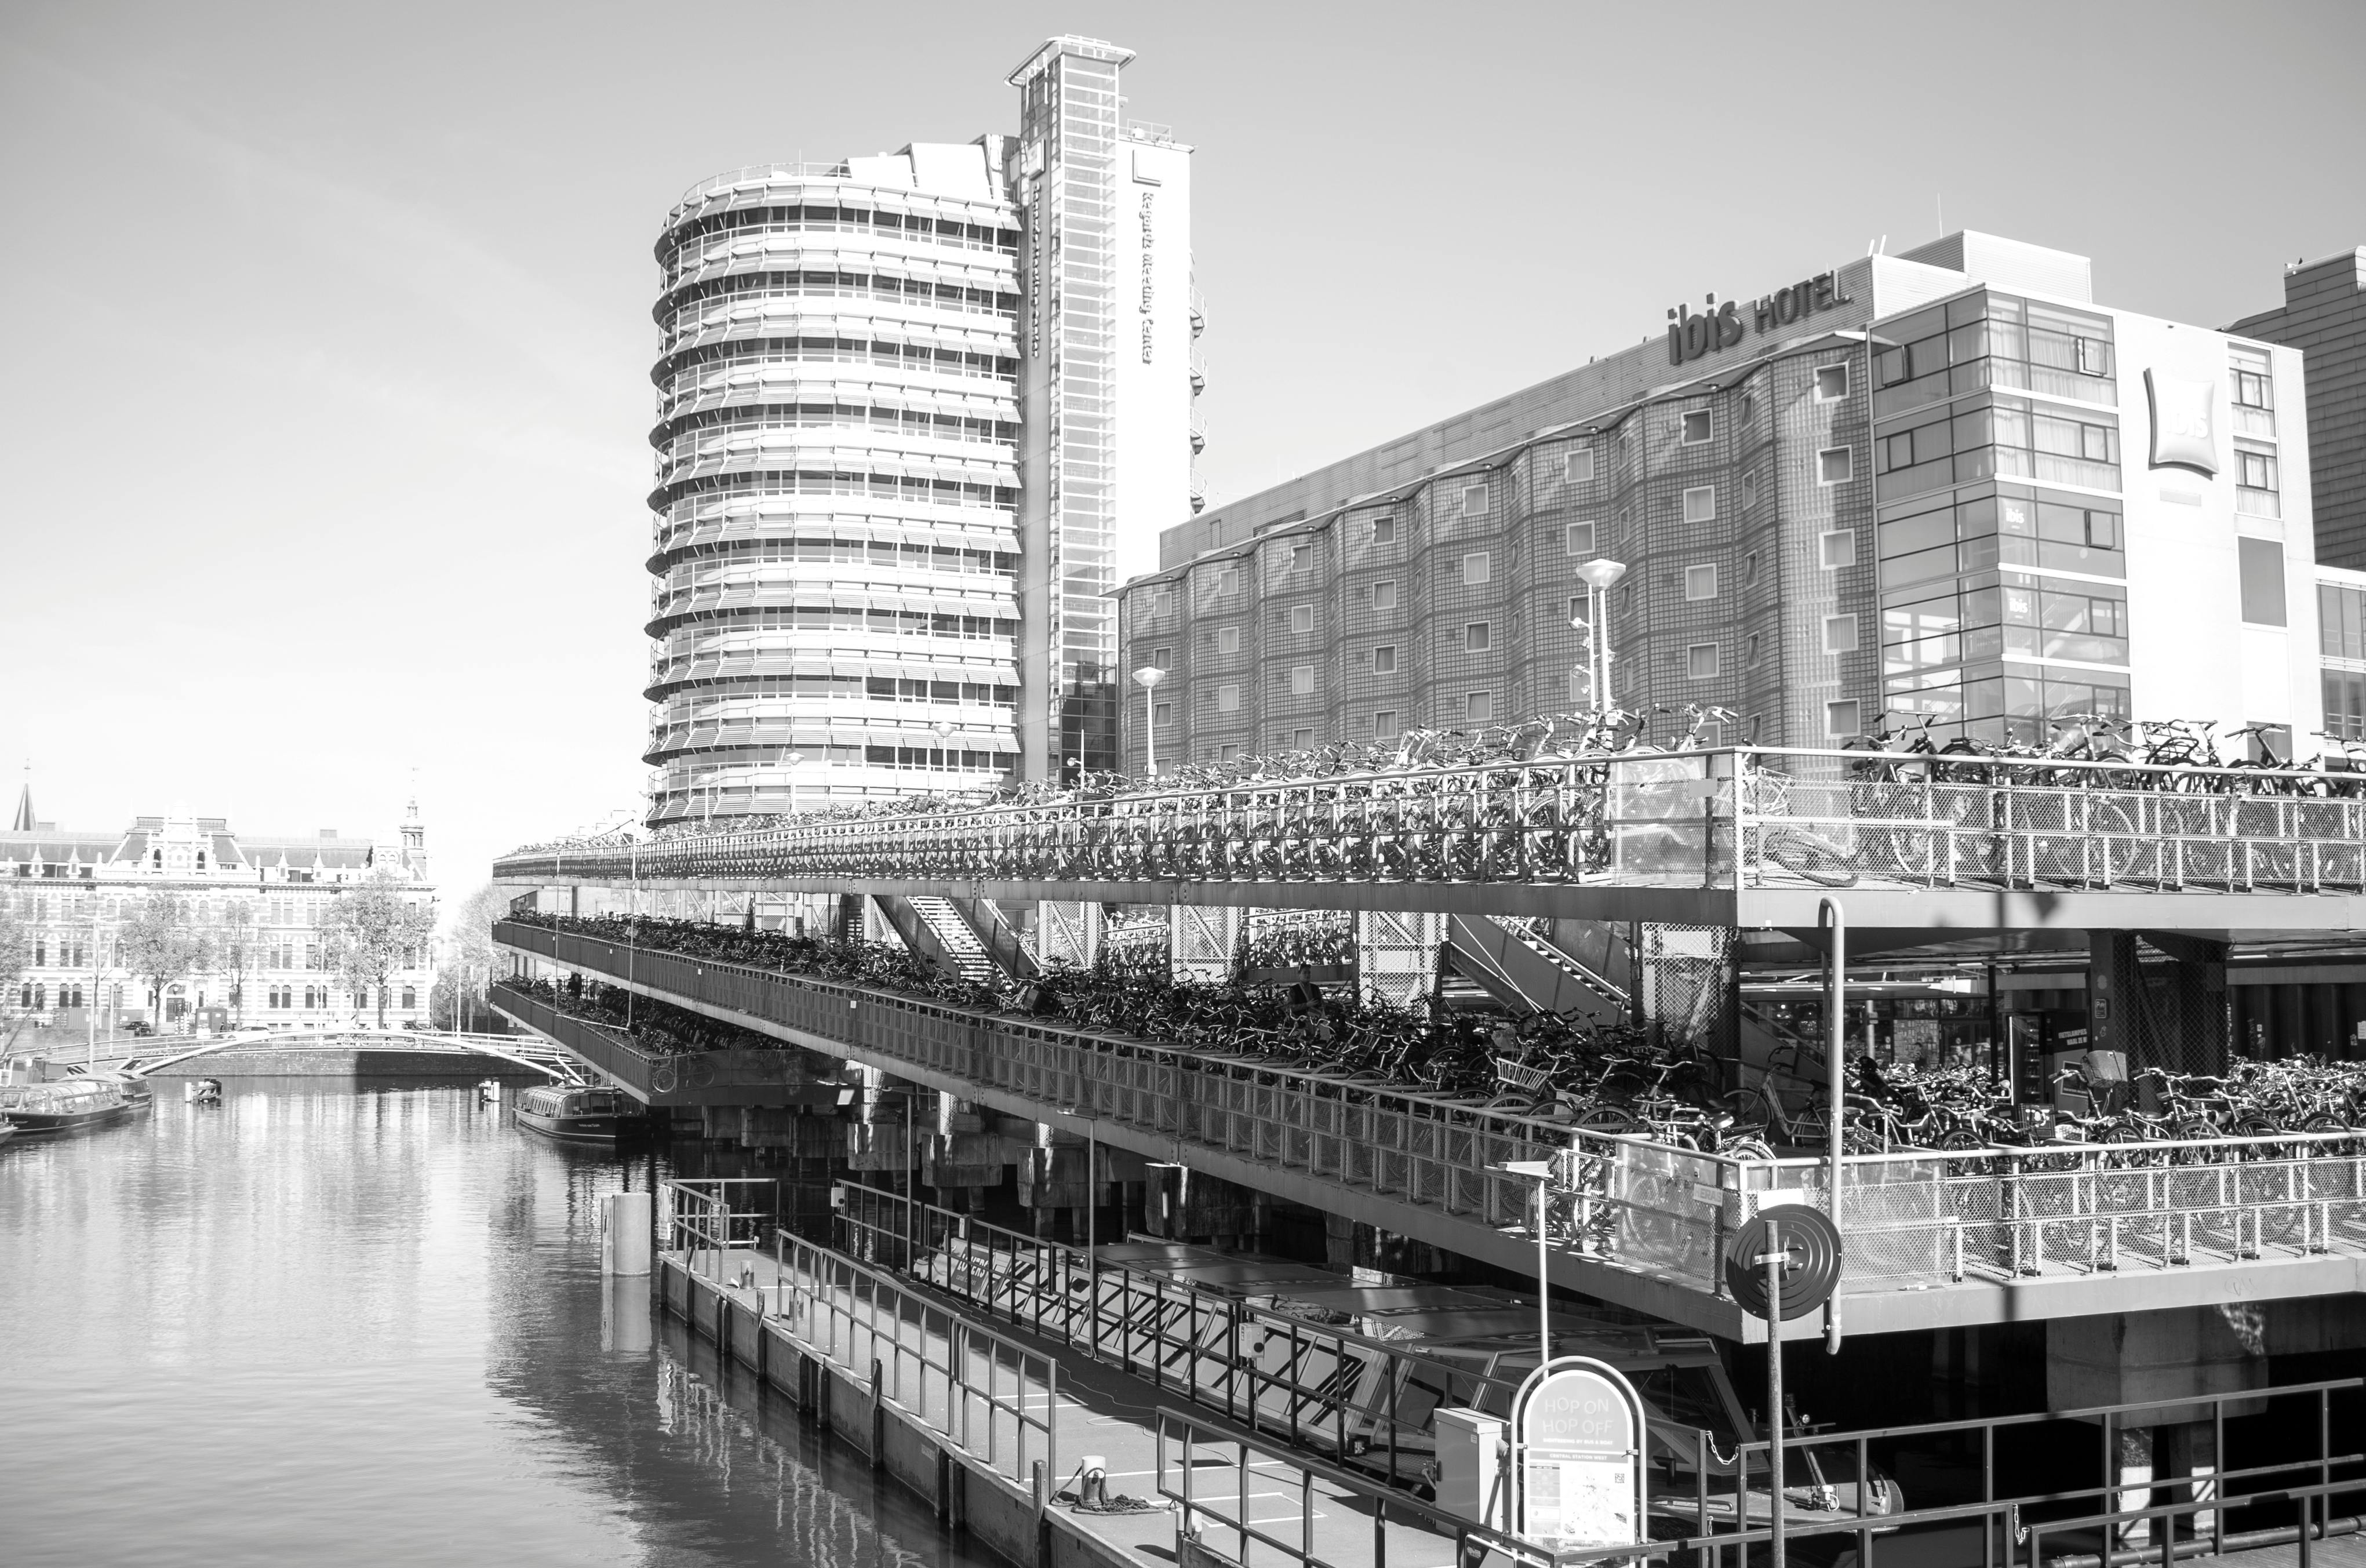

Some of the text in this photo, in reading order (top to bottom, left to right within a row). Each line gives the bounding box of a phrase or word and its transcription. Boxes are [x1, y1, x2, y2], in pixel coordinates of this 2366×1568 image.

[1139, 253, 1154, 314] Meeting
[1668, 269, 1851, 365] ibis HOTEL
[2165, 405, 2209, 440] ibis
[2005, 508, 2025, 524] ibis
[2009, 598, 2028, 613] ibis
[1545, 1397, 1609, 1414] HOP ON
[1542, 1419, 1614, 1436] HOP OFF
